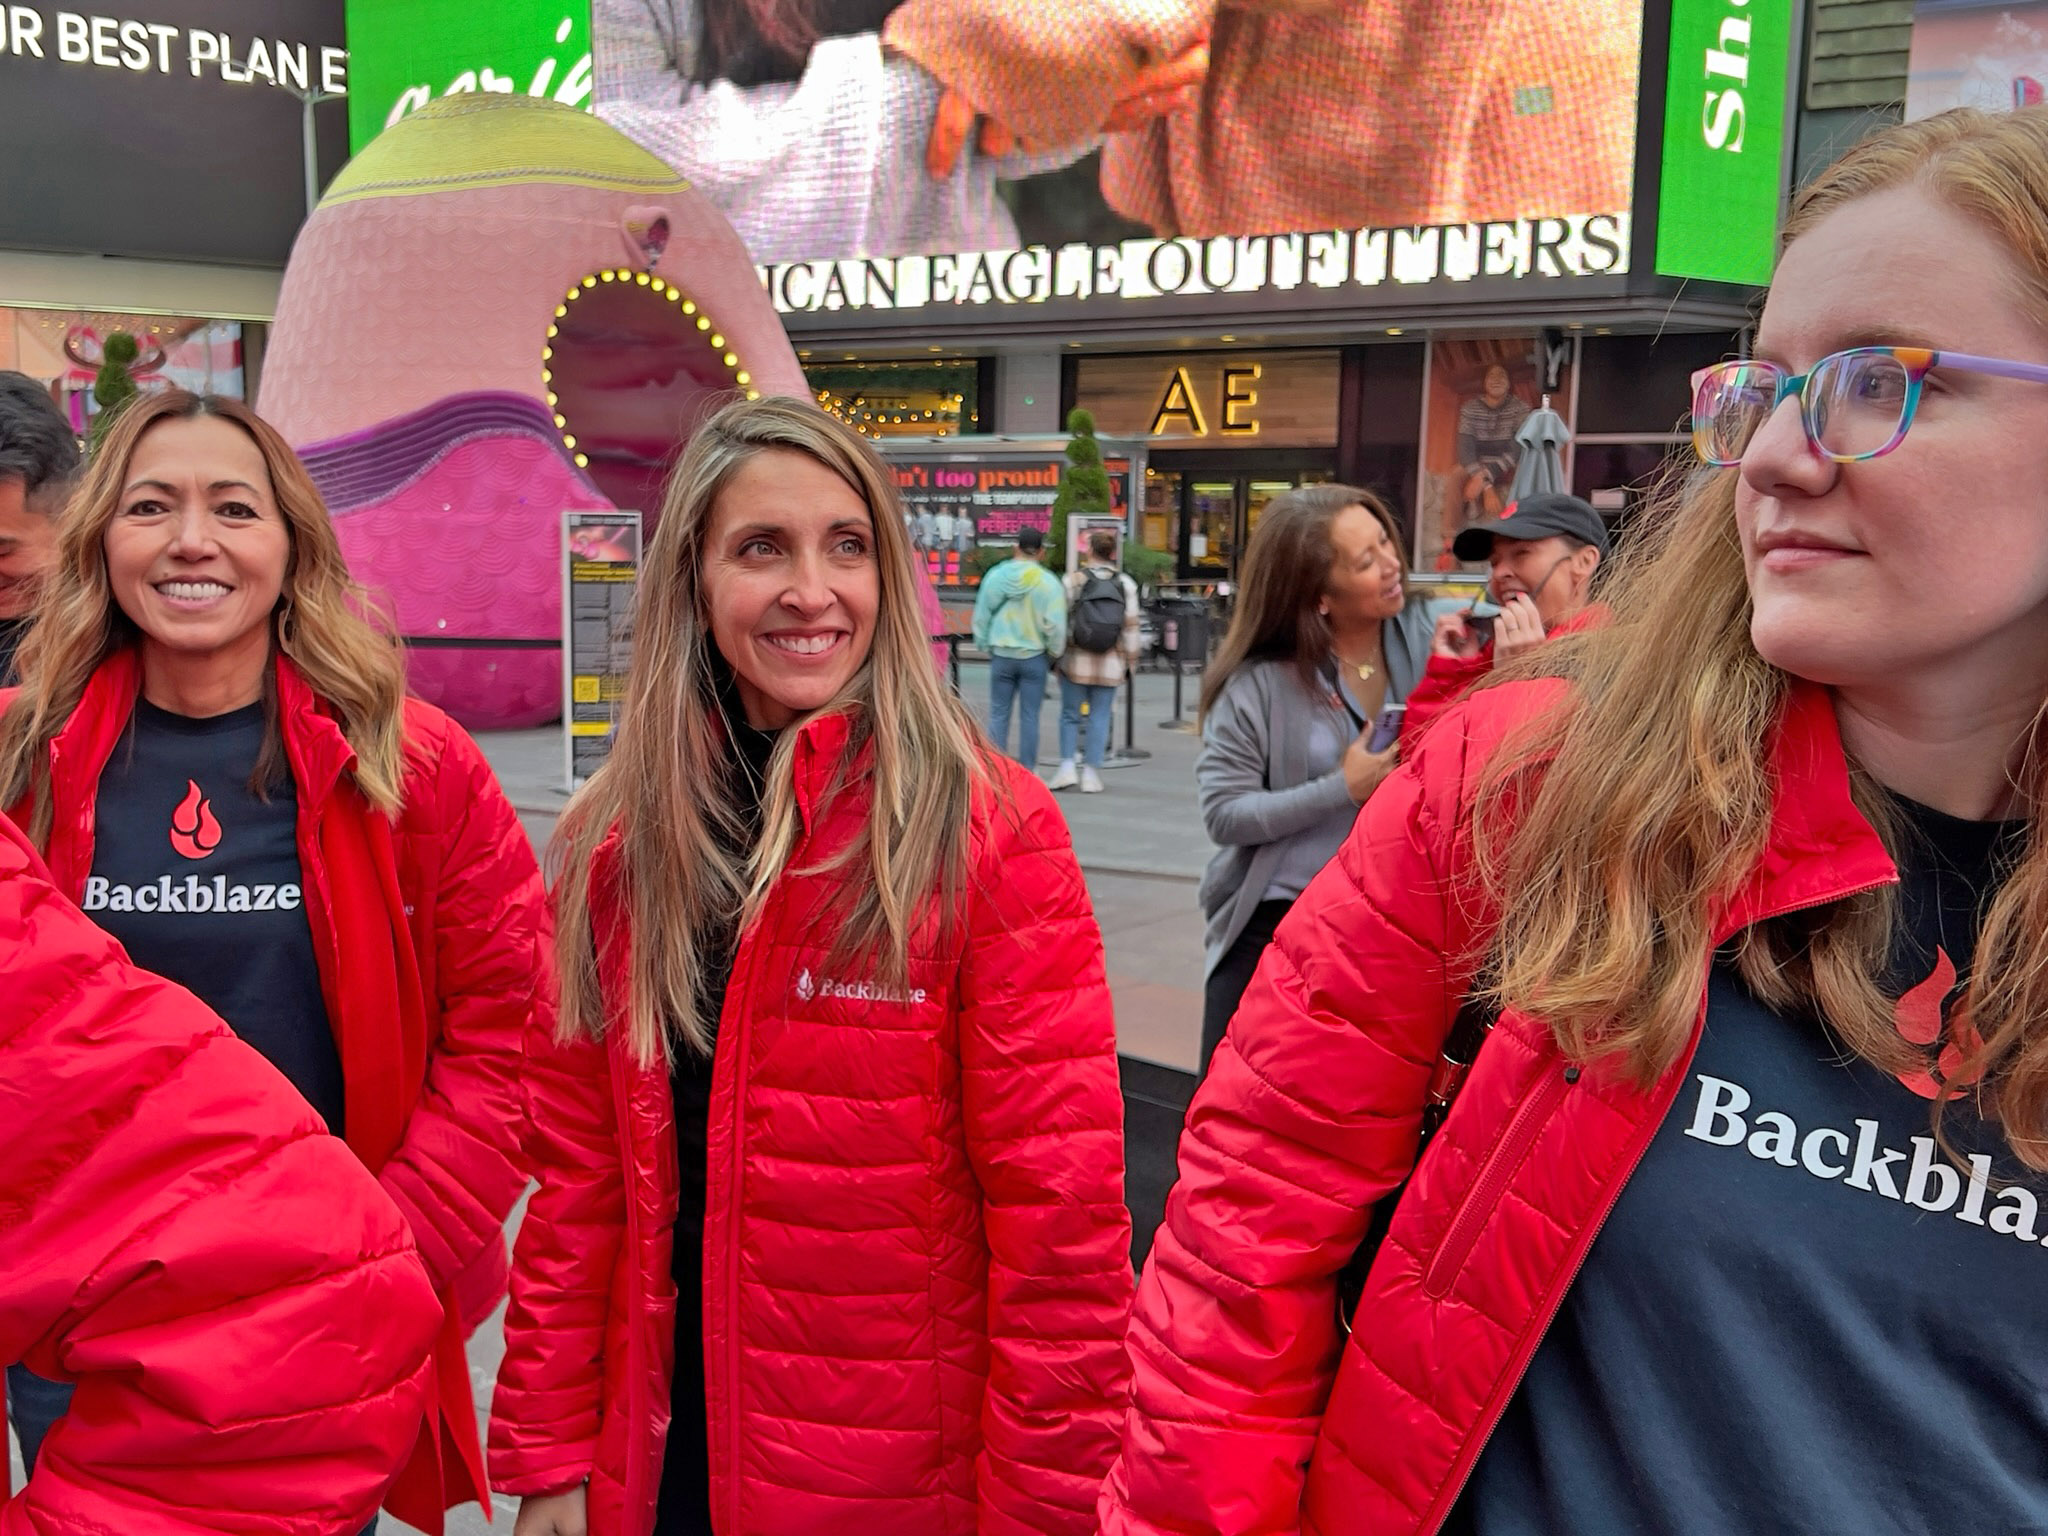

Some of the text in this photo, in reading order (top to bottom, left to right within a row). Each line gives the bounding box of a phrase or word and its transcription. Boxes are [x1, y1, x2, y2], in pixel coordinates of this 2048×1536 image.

[0, 4, 44, 58] R
[57, 12, 179, 74] BEST
[189, 28, 308, 90] PLAN
[1703, 0, 1752, 152] Sh
[929, 243, 1124, 304] EAGLE
[1146, 214, 1624, 294] OUTFITTERS
[1150, 364, 1262, 437] AE
[935, 468, 977, 488] too
[978, 463, 1060, 493] proud
[82, 874, 301, 914] Backblaze
[1684, 1073, 2048, 1249] Backbla
